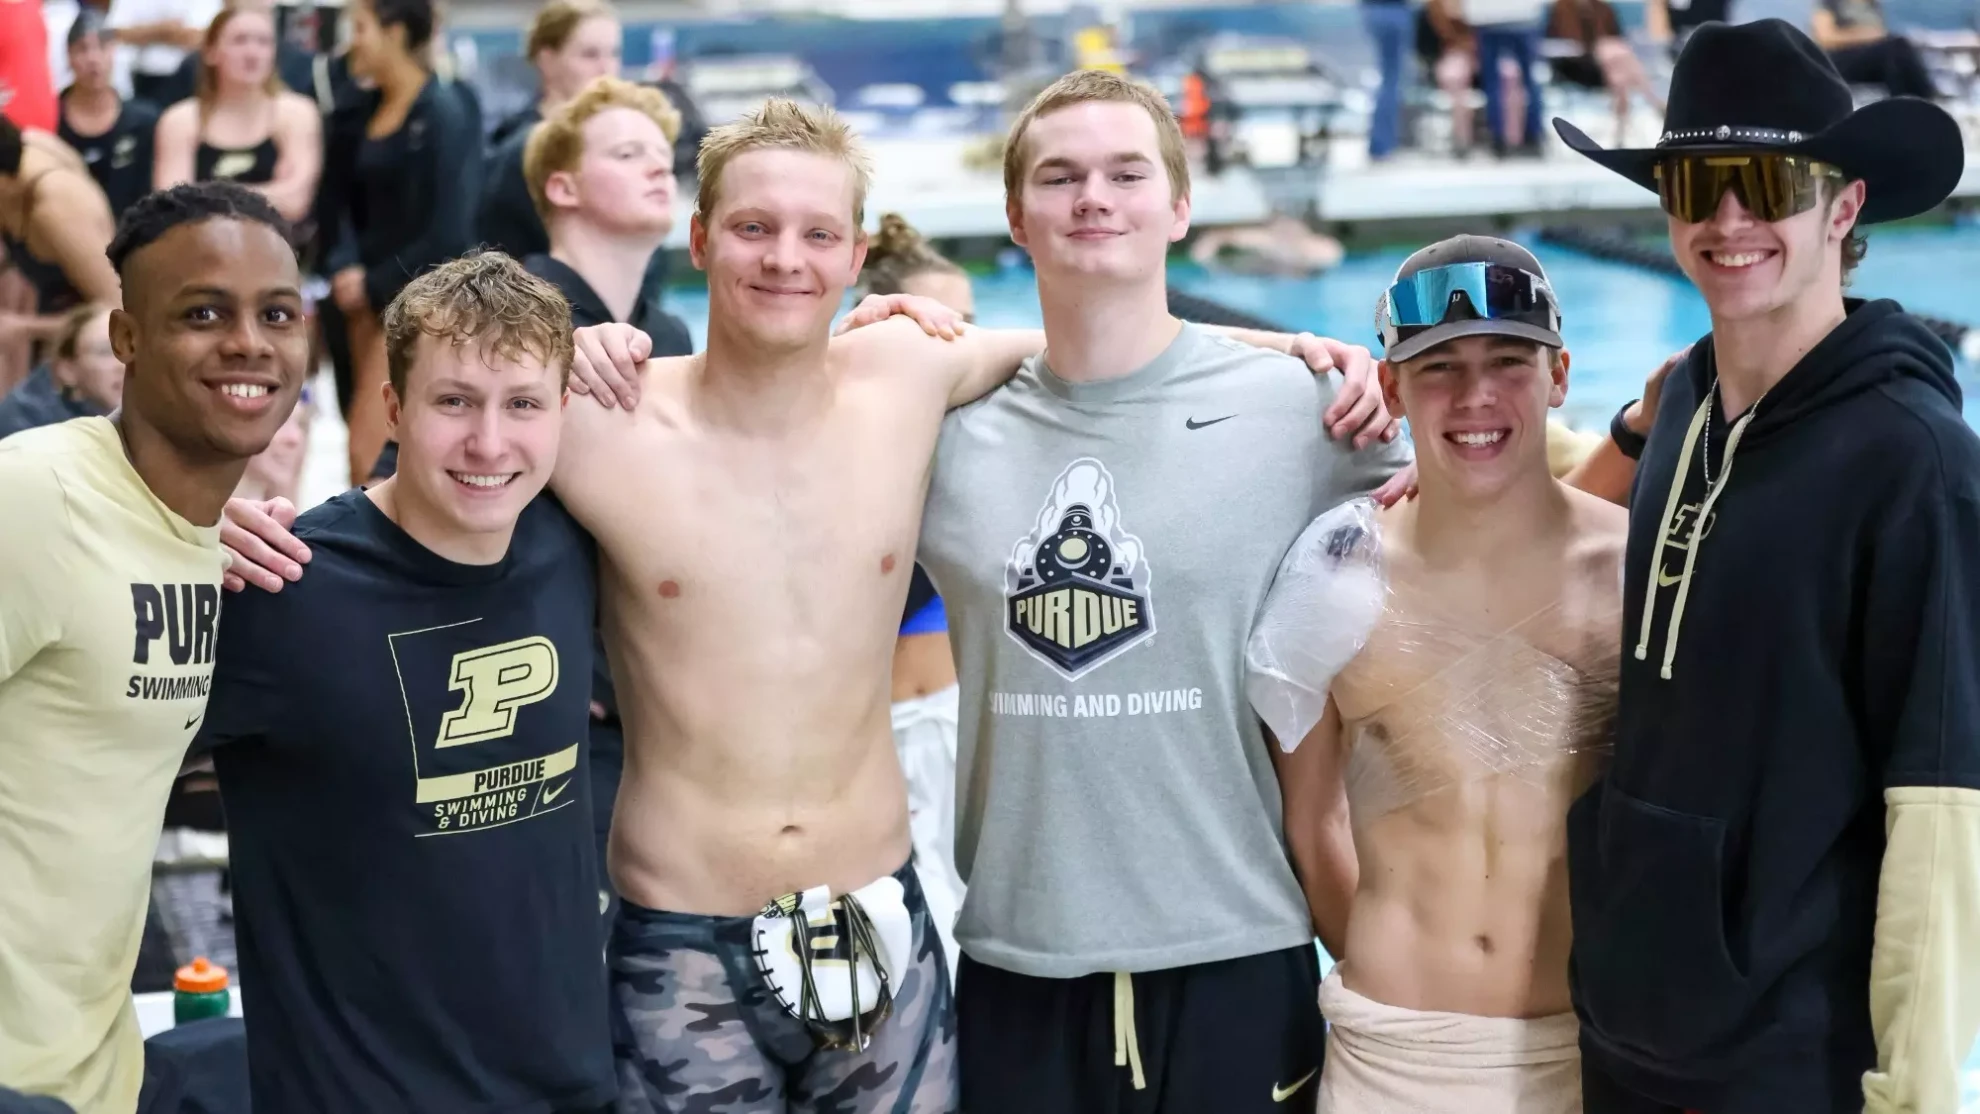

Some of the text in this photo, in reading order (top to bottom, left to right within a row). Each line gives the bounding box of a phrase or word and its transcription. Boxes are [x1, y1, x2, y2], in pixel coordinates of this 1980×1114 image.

[130, 583, 222, 665] PUR
[1016, 588, 1138, 649] PURDUE
[126, 675, 210, 700] SWIMMING
[434, 635, 559, 749] P
[1073, 694, 1121, 717] AND
[1127, 687, 1203, 716] DIVING
[474, 759, 546, 793] PURDUE
[434, 788, 527, 818] SWIMMING
[438, 803, 518, 829] & DIVING
